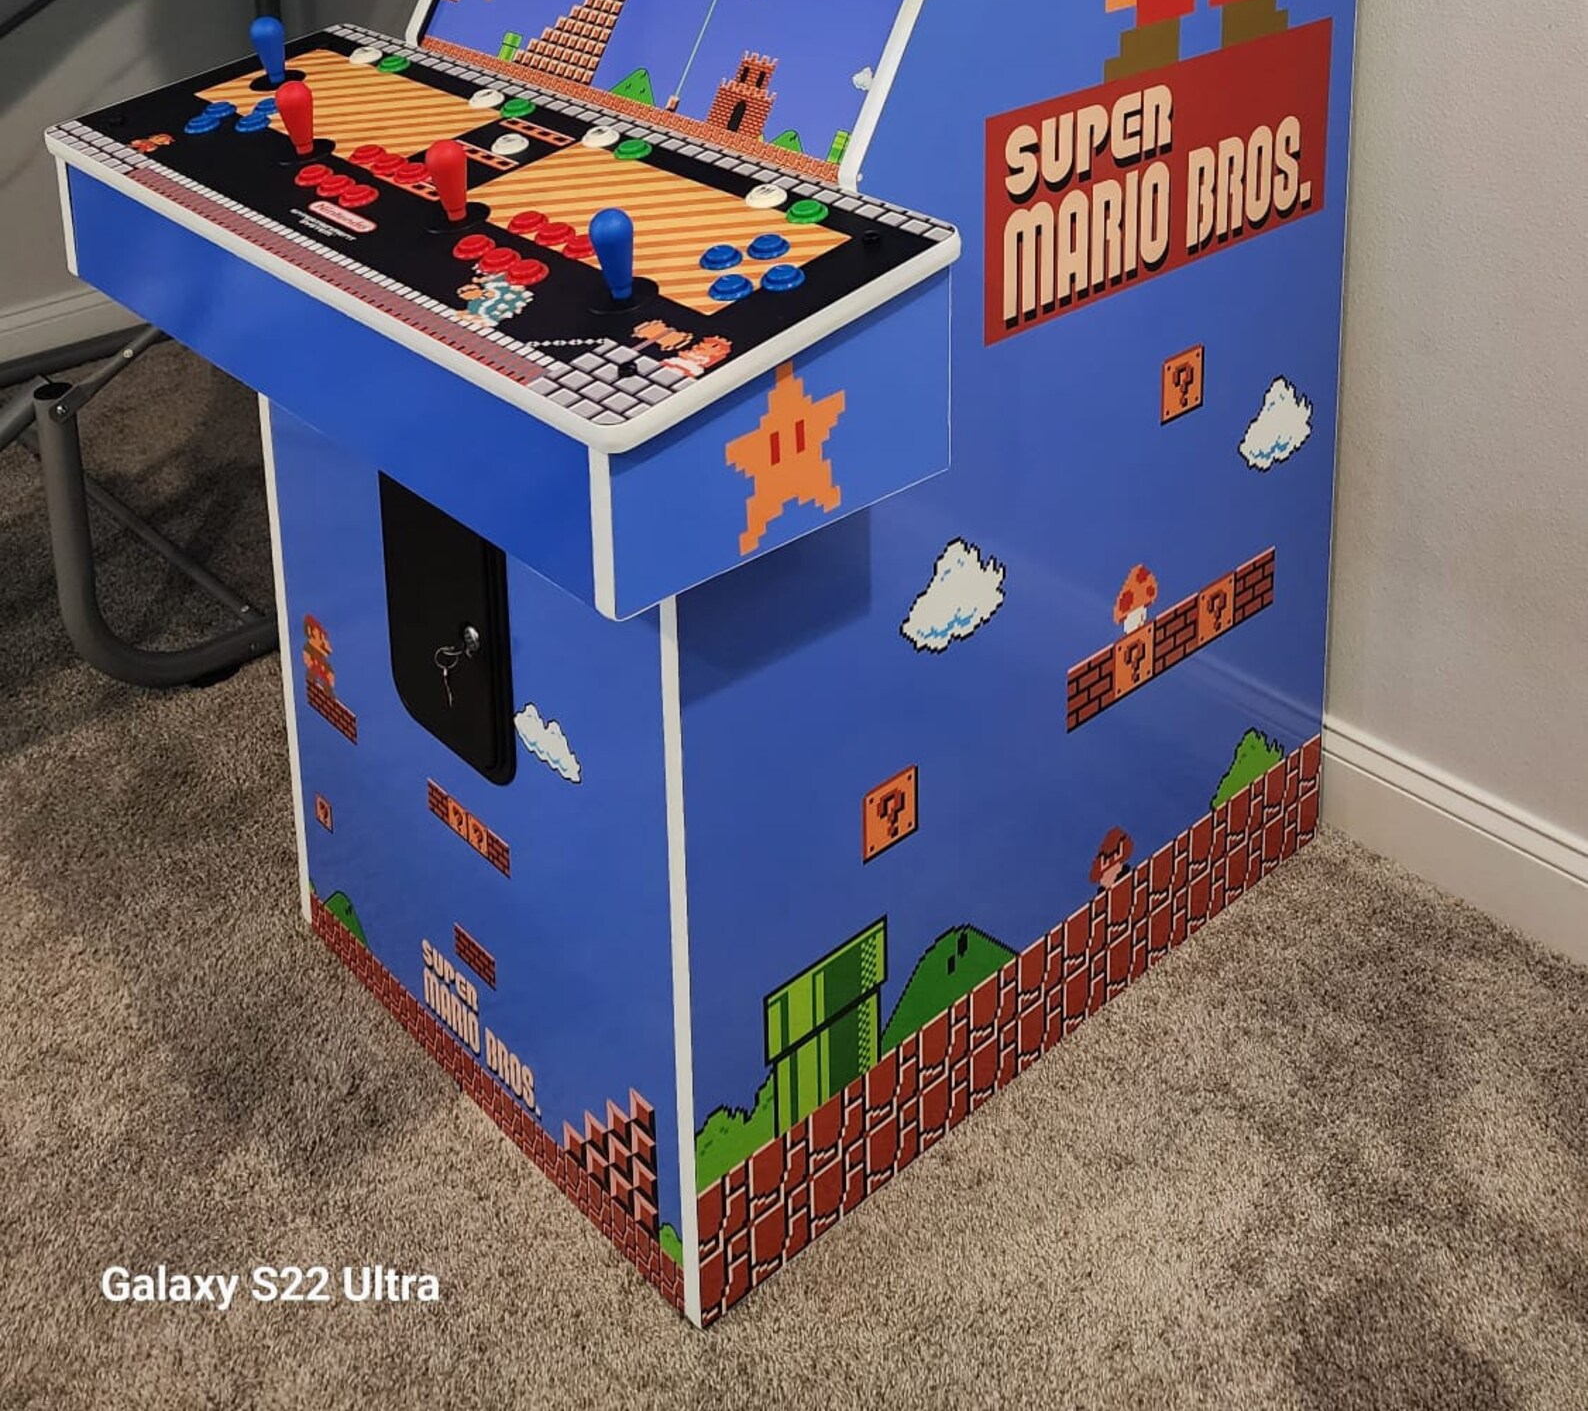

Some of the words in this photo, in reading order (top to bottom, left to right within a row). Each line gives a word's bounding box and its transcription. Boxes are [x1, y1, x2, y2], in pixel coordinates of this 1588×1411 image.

[1005, 84, 1173, 205] SUPER
[1003, 160, 1170, 330] MARIO
[1186, 115, 1312, 255] BROS.
[421, 938, 478, 1015] SUPER
[423, 967, 481, 1057] MARIO
[484, 1026, 542, 1120] BROS.
